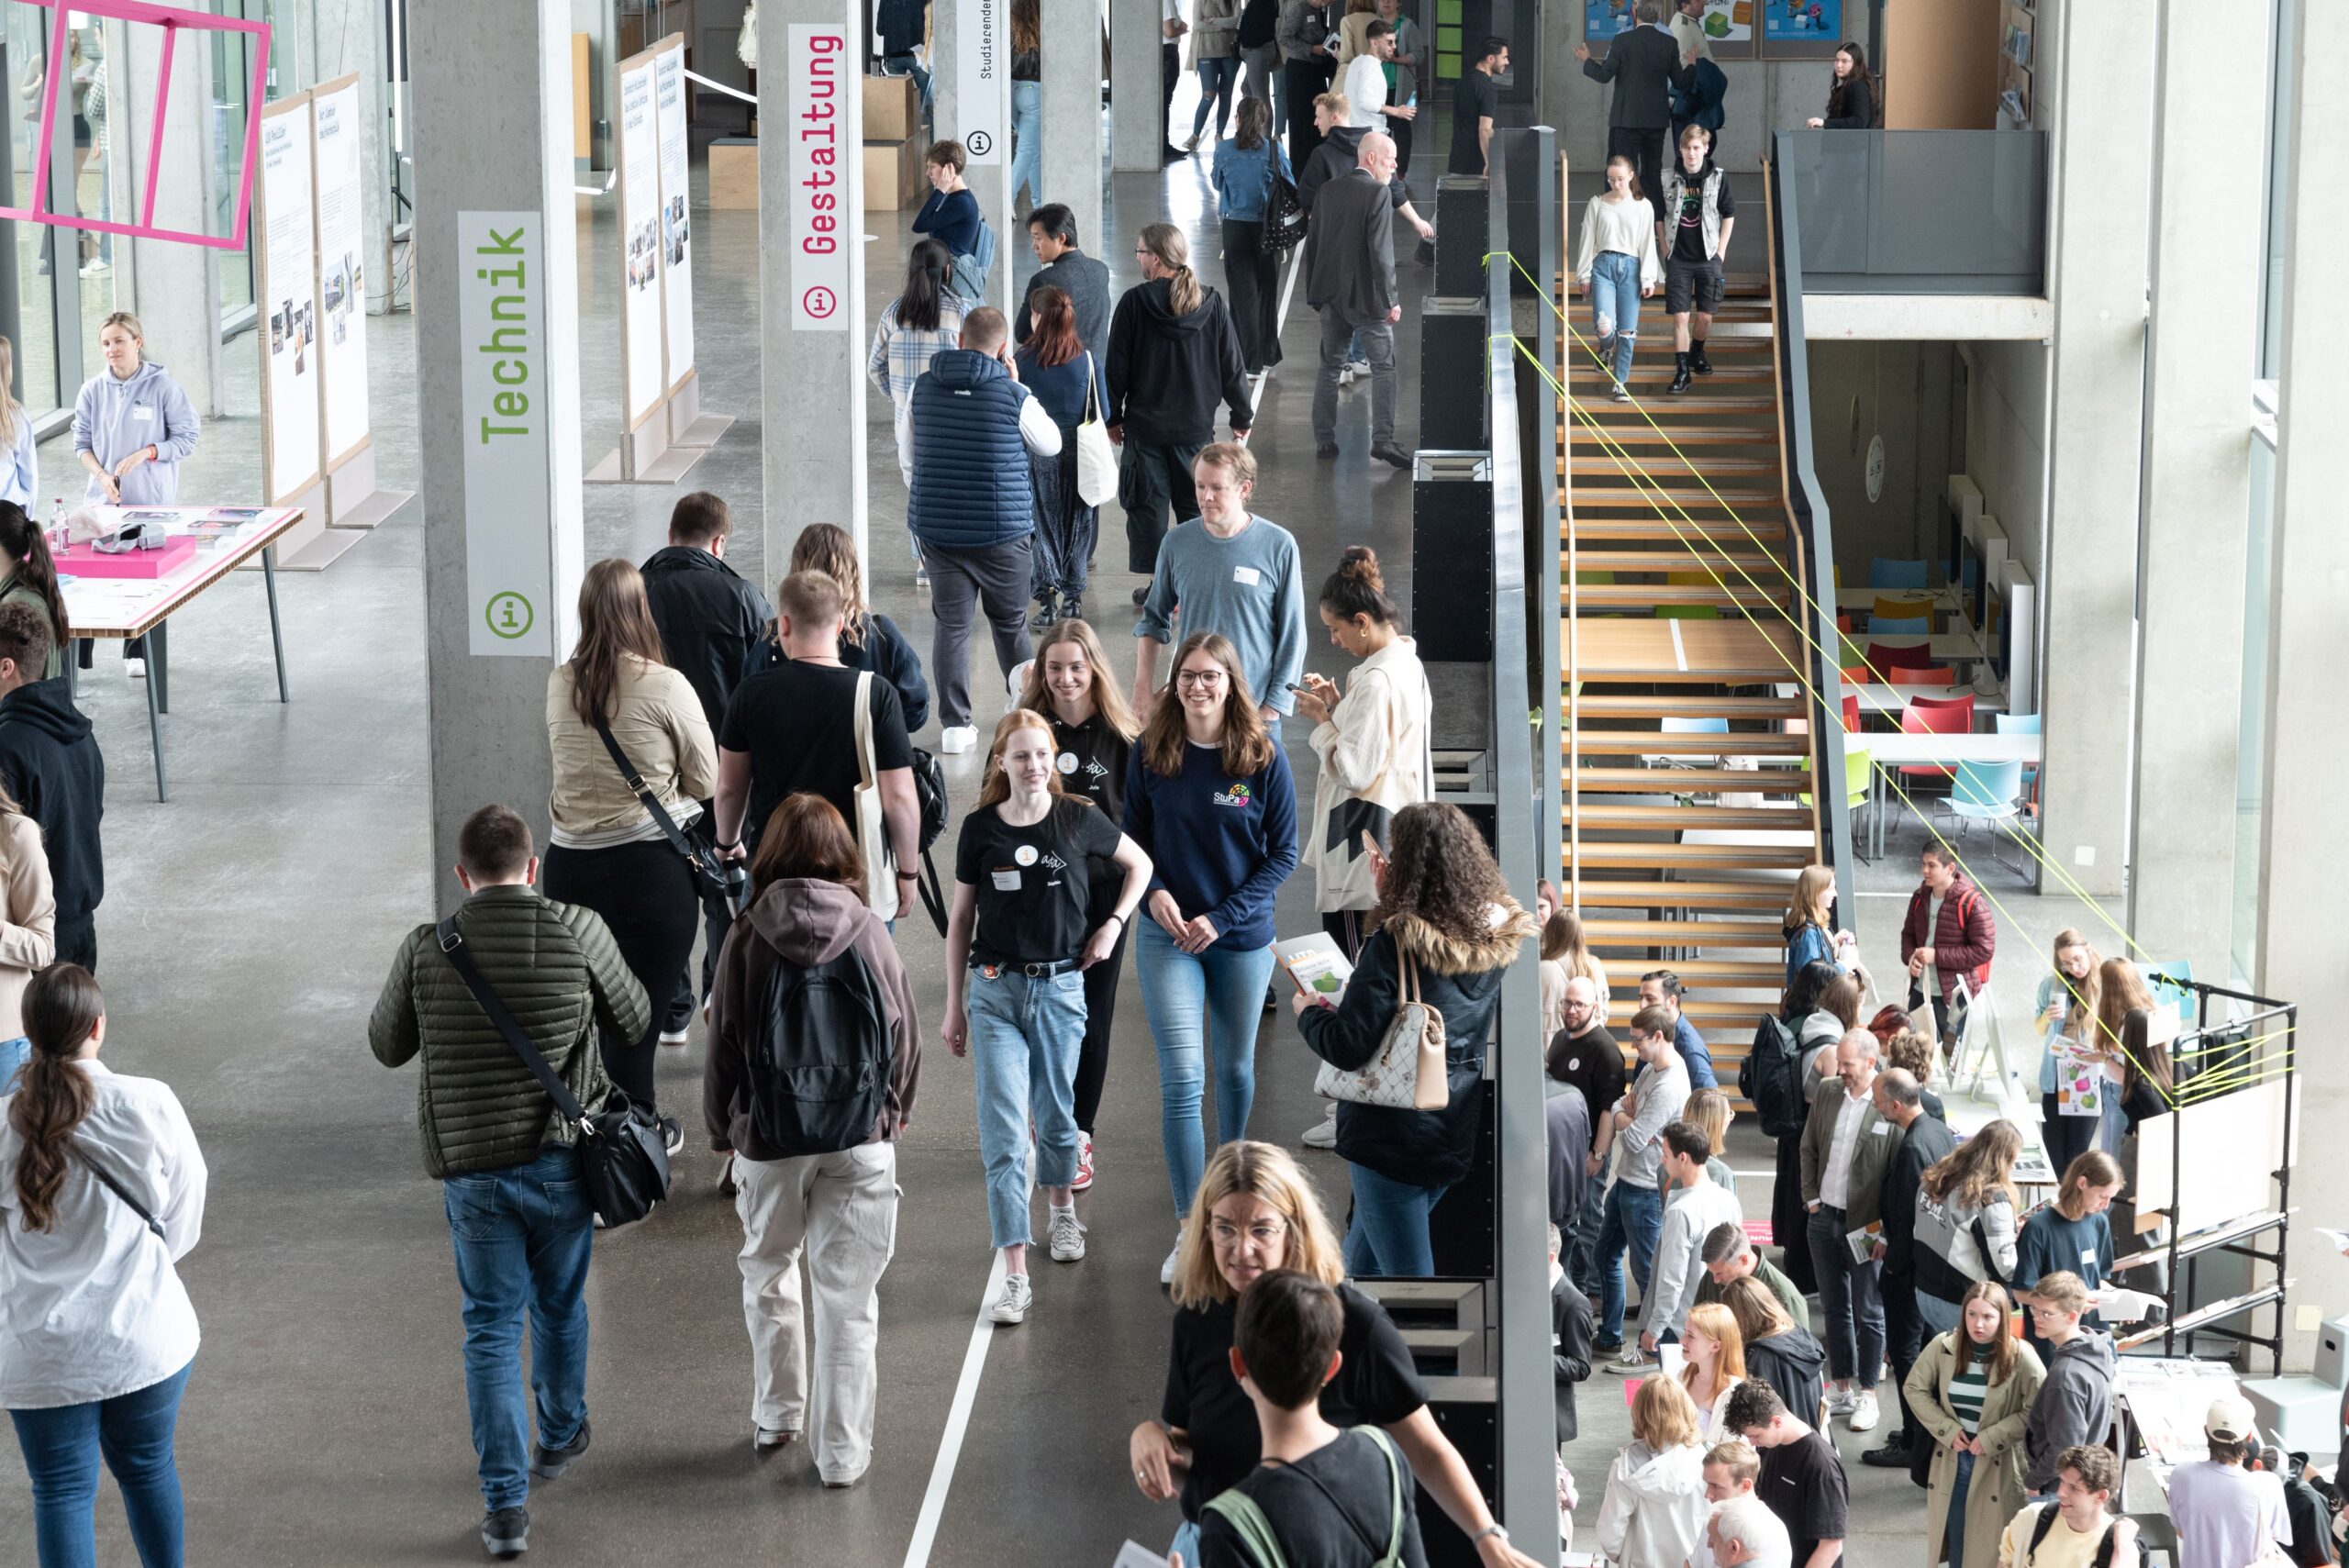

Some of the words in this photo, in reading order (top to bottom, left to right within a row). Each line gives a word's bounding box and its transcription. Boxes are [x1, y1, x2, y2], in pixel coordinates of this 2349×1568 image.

[801, 35, 844, 255] Gestaltung
[477, 228, 529, 443] Technik
[1213, 792, 1240, 804] StuPa
[1041, 853, 1062, 869] asta
